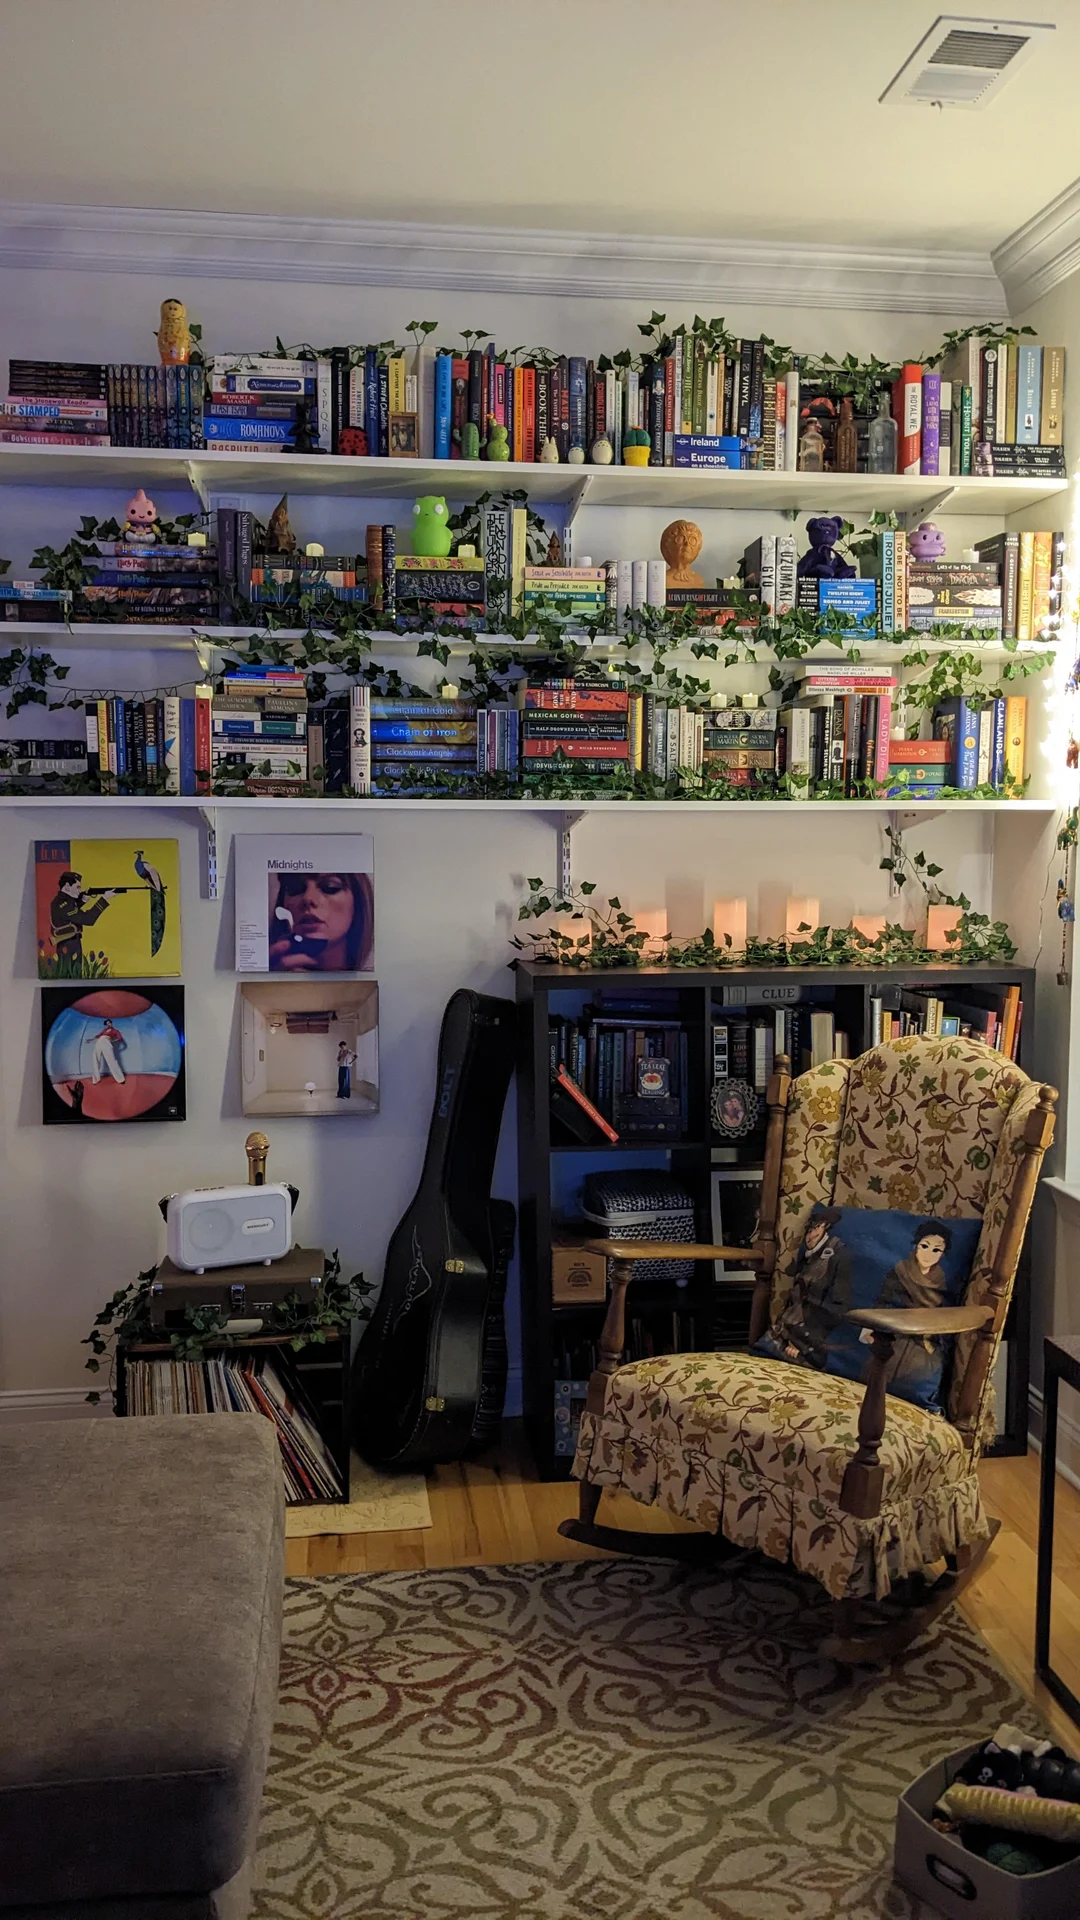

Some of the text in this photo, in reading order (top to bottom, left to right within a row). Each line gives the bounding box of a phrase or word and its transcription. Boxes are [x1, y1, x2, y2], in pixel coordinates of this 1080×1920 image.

[19, 405, 60, 417] STAMPED
[910, 418, 917, 429] WE
[690, 438, 720, 447] Ireland
[691, 453, 726, 462] Europe
[896, 542, 902, 552] TO
[896, 555, 902, 565] BE
[762, 567, 774, 587] GYO
[780, 551, 792, 601] UZUMAKI
[896, 595, 902, 605] TO
[896, 608, 902, 617] BE
[391, 727, 420, 736] Chain
[996, 702, 1004, 754] CLANLANDS
[880, 746, 887, 756] DI
[267, 860, 313, 871] Midnights
[762, 989, 795, 999] CLUE
